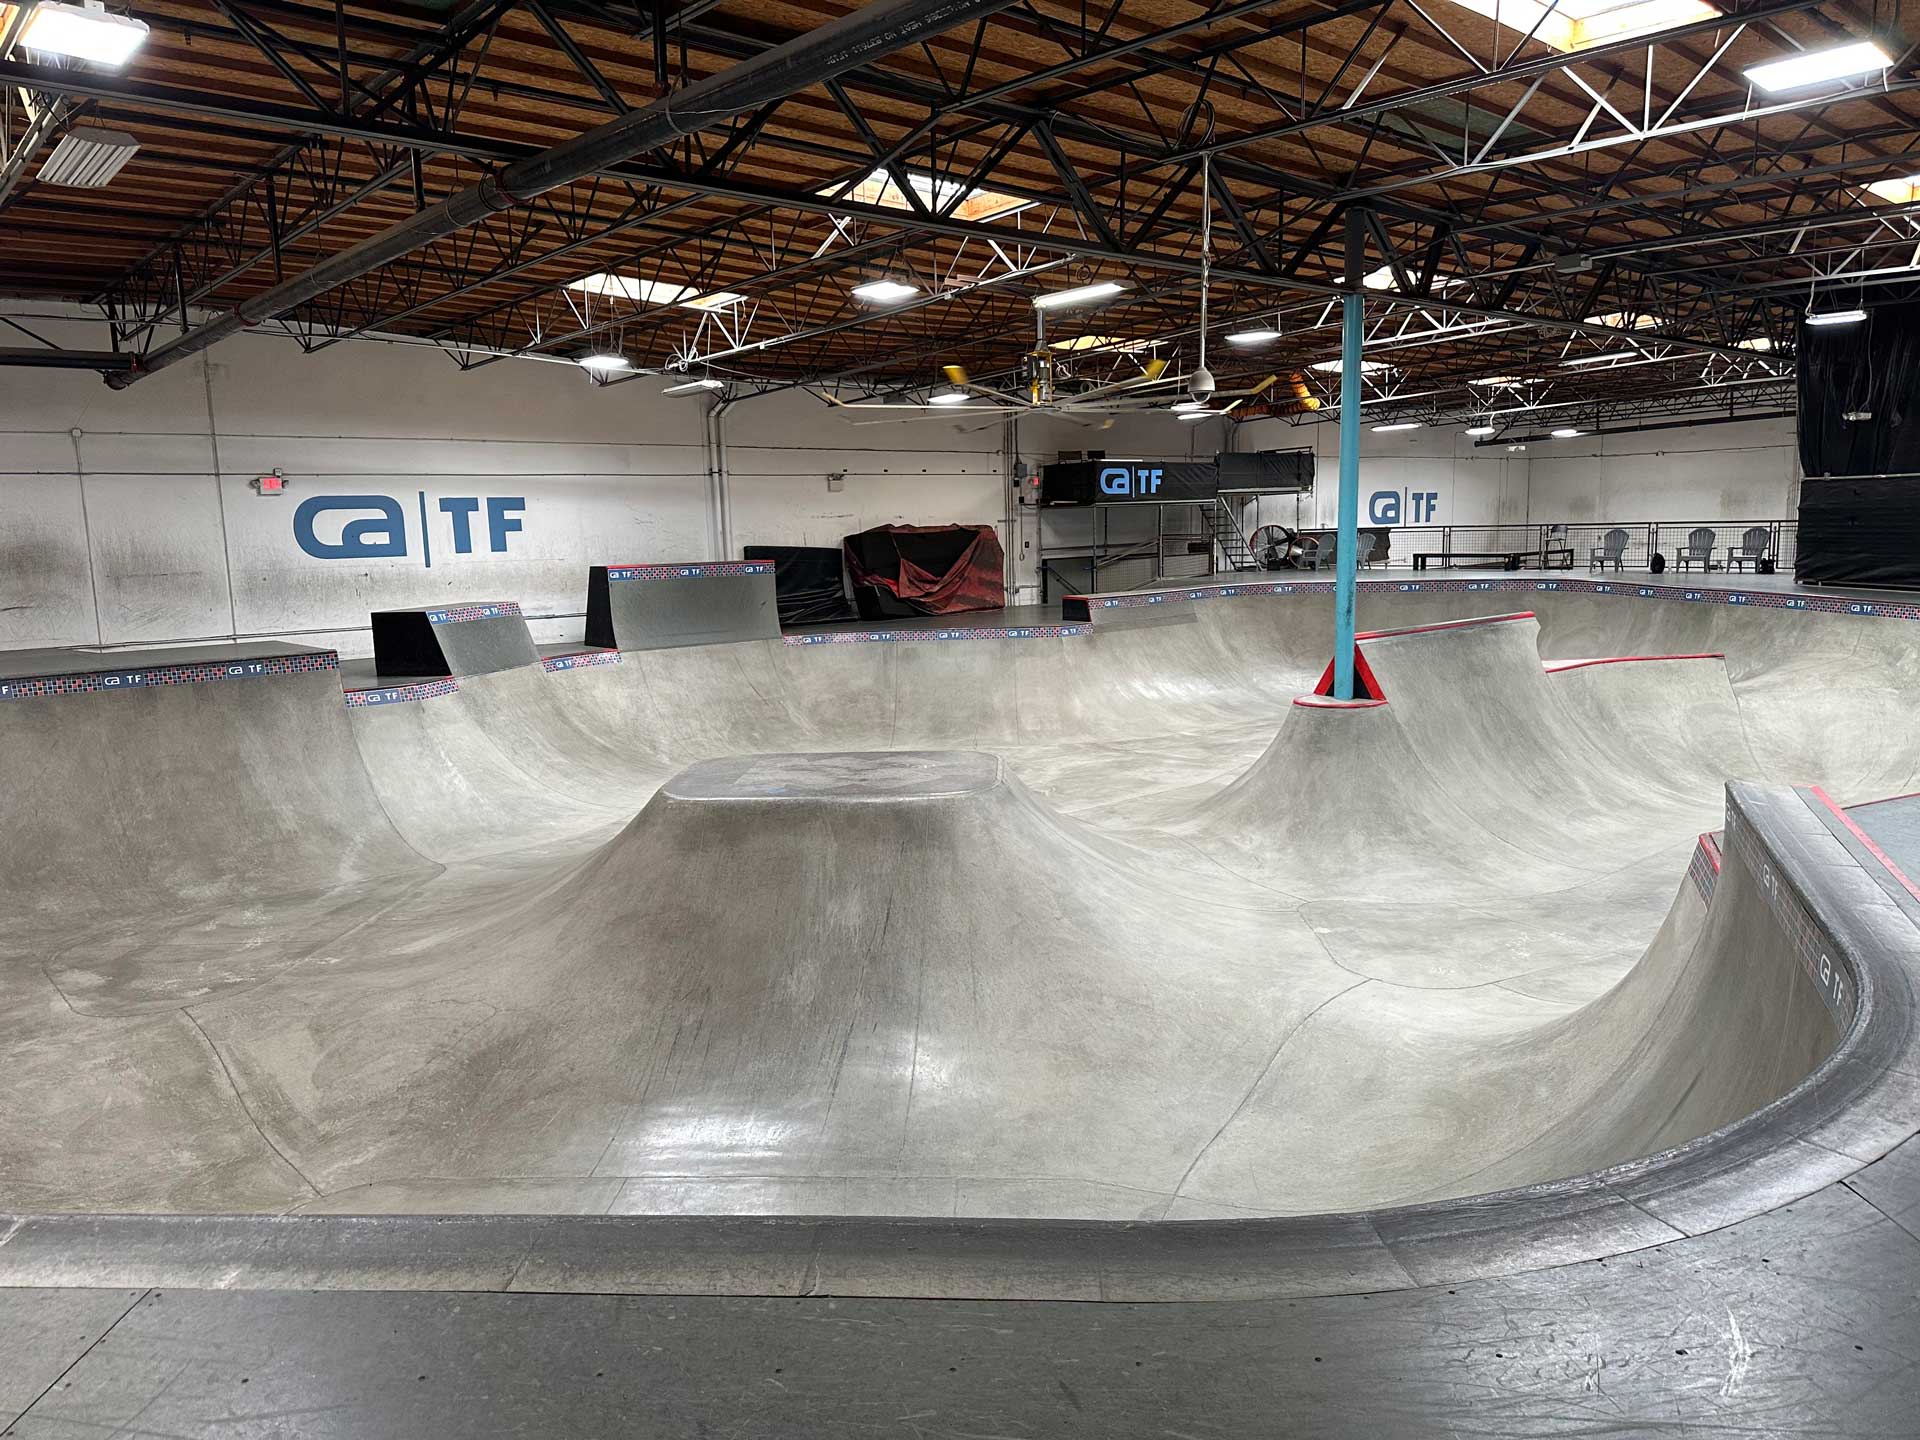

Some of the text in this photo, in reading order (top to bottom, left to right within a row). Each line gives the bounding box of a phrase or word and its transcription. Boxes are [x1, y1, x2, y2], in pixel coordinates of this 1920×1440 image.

[1138, 469, 1164, 495] TF
[1411, 492, 1438, 523] TF
[439, 497, 525, 553] TF
[621, 570, 632, 578] TF
[1797, 599, 1806, 608] TF
[490, 606, 499, 615] TF
[1863, 604, 1873, 613] TF
[438, 612, 448, 621] TF
[950, 631, 960, 639] TF
[248, 664, 262, 673] TF
[565, 660, 573, 668] TF
[126, 674, 142, 684] TF
[383, 691, 398, 701] TF
[1771, 874, 1779, 898] TF
[1832, 972, 1844, 1006] TF
